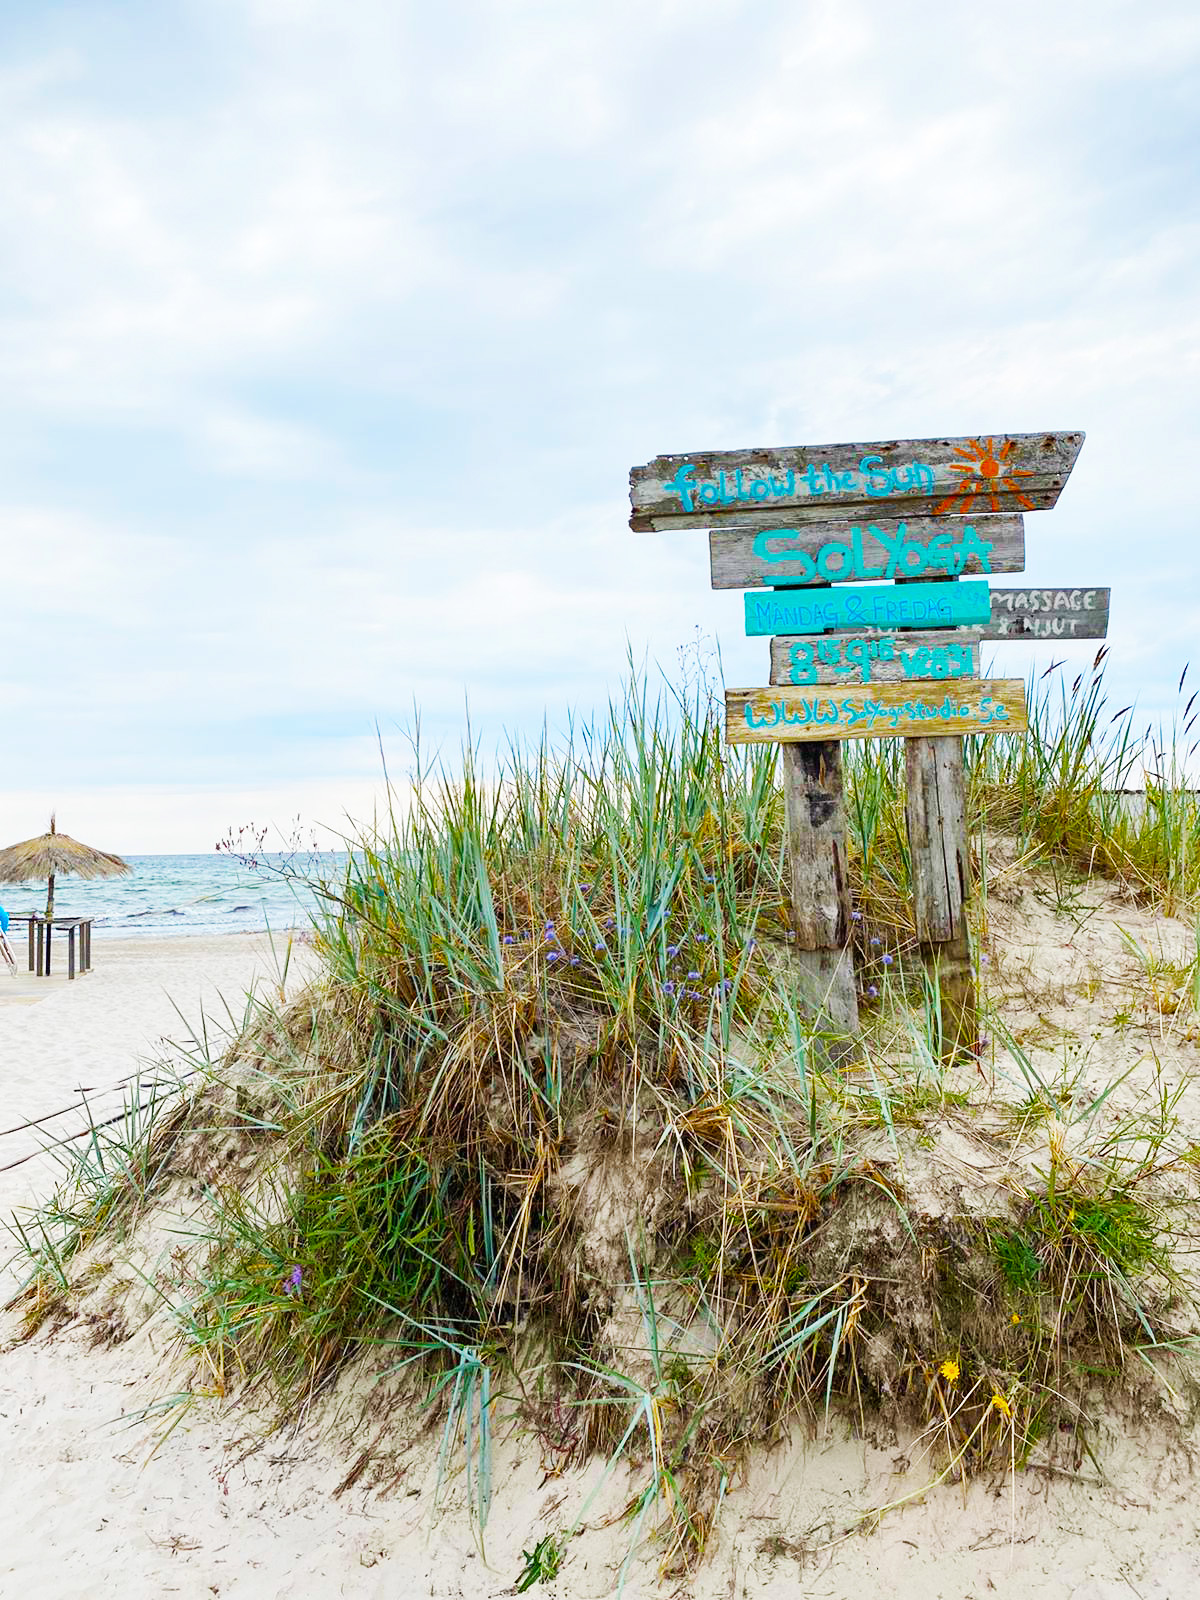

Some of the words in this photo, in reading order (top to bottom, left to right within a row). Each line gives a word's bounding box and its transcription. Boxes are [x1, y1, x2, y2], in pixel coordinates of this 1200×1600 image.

[664, 463, 796, 513] follow
[801, 462, 858, 496] the
[859, 455, 936, 497] Sun
[755, 600, 840, 630] MÅNDAG
[845, 595, 870, 624] &
[872, 594, 954, 622] FREDAG
[989, 589, 1097, 612] MASSAGE
[1023, 617, 1081, 638] NJUT
